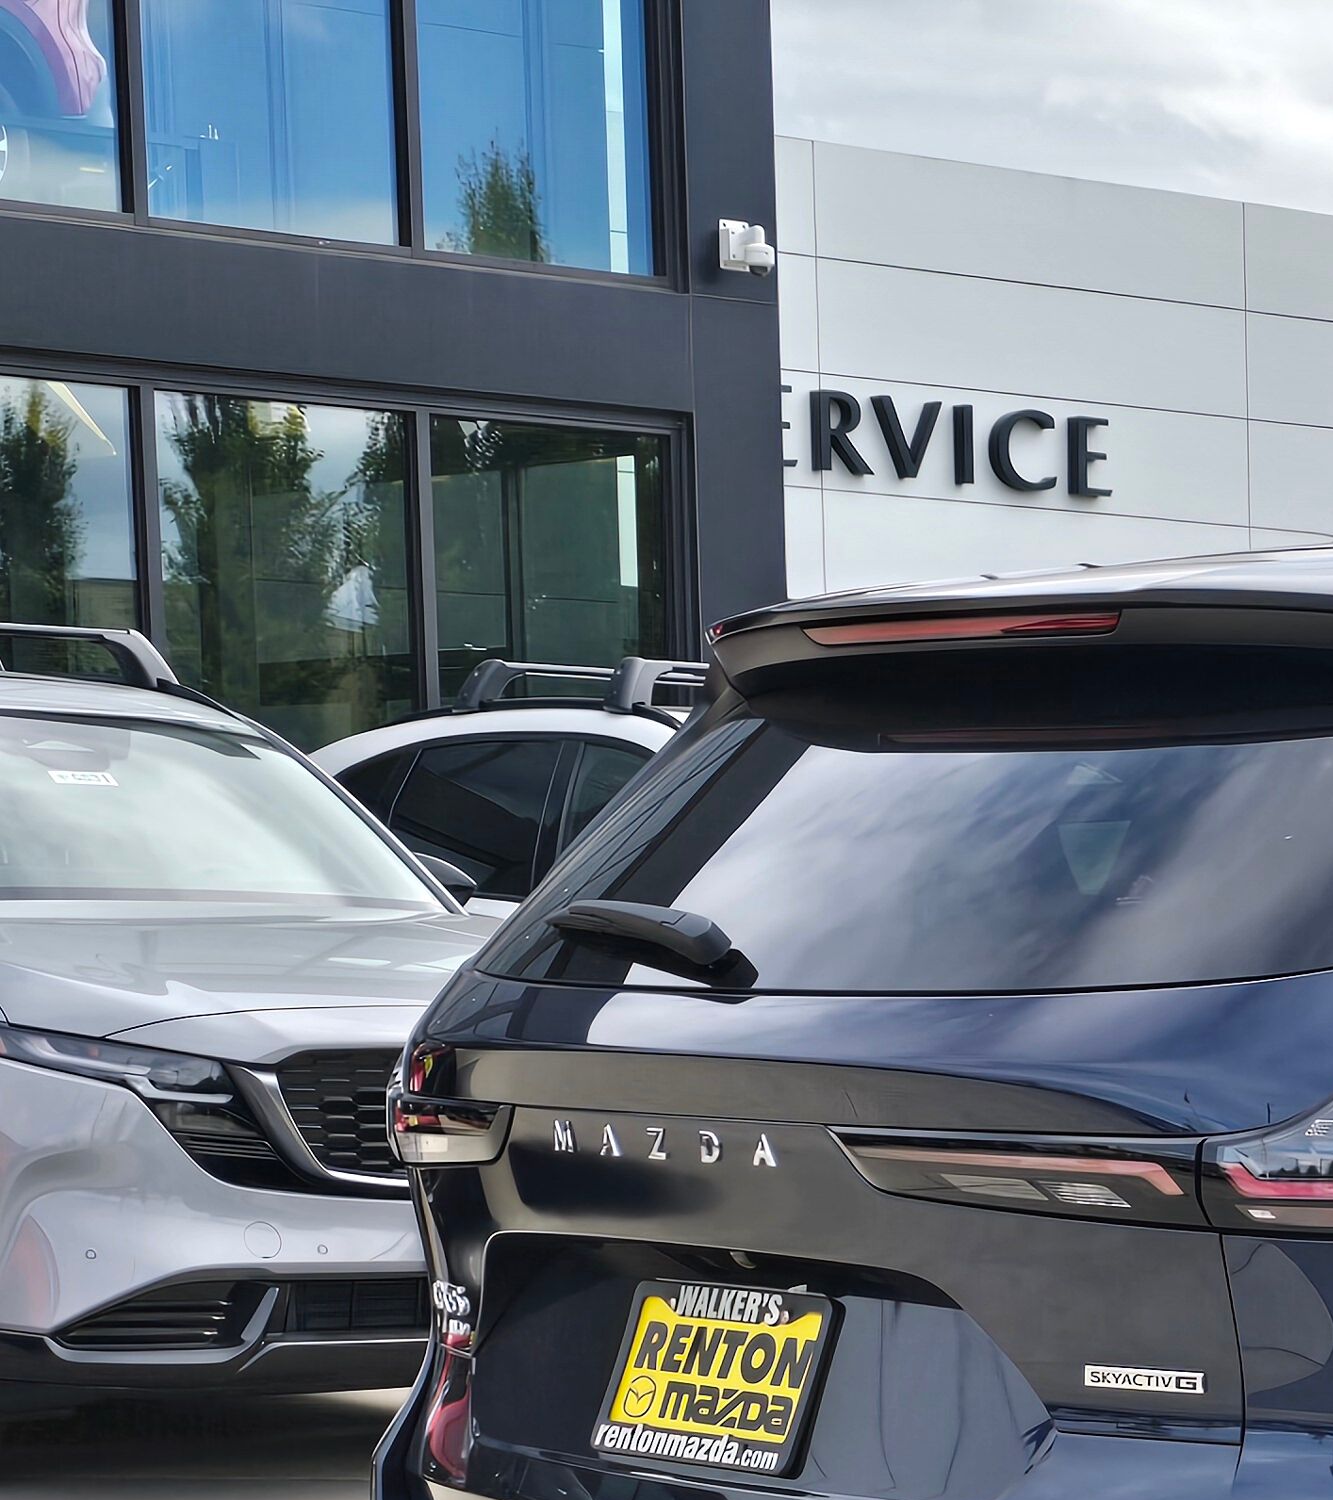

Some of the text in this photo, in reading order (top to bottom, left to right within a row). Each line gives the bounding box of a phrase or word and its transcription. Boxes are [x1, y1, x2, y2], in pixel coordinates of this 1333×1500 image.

[553, 1119, 778, 1168] MAZDA
[676, 1284, 783, 1325] WALKER'S
[634, 1320, 818, 1390] RENTON
[594, 1423, 779, 1471] rentonmazda.com
